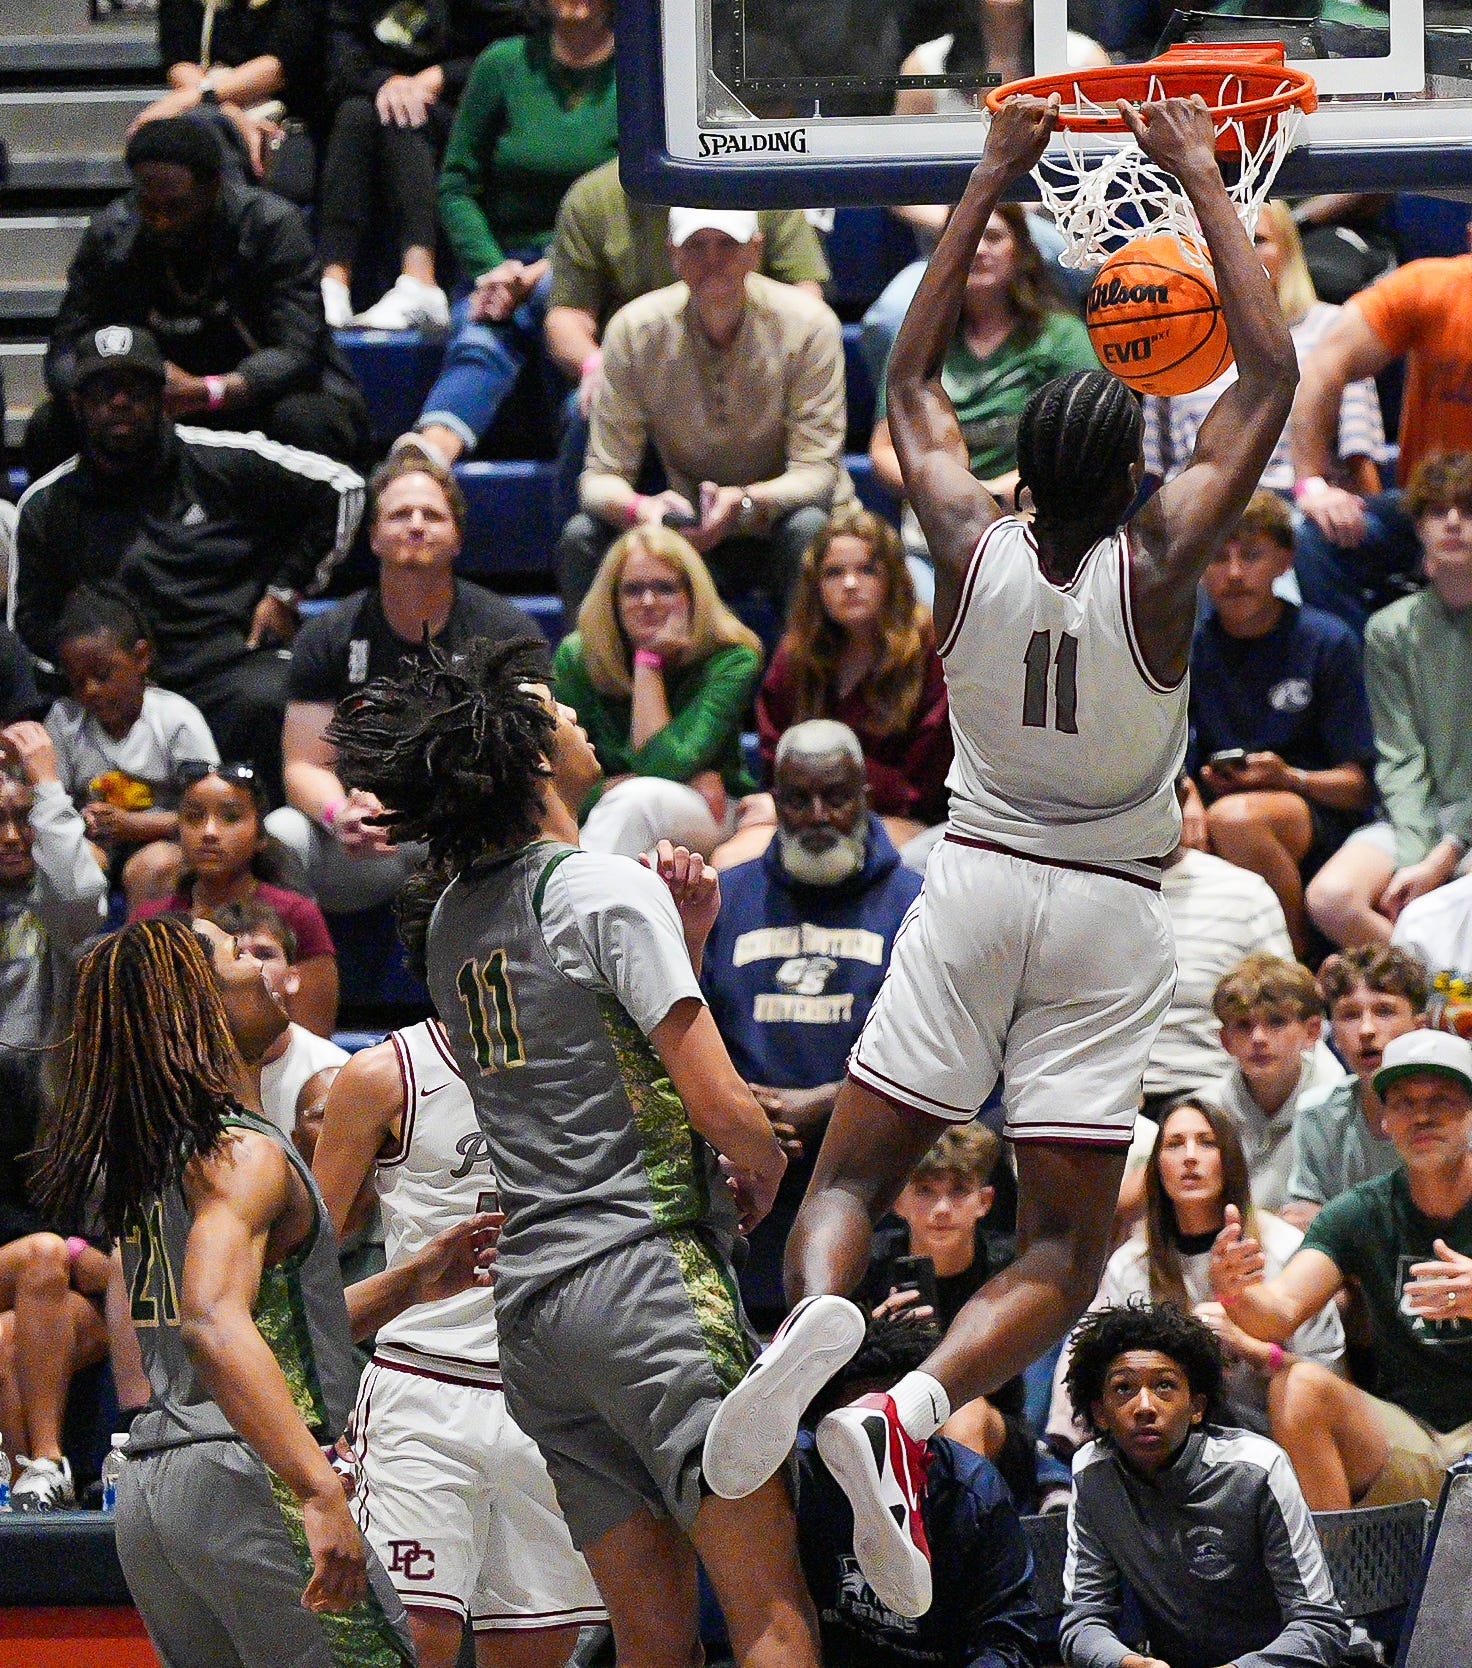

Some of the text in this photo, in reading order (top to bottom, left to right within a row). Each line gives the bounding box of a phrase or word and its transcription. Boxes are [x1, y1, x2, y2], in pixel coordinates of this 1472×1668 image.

[698, 128, 806, 158] SPALDING
[1103, 337, 1152, 364] EVO
[1022, 628, 1079, 735] 11
[456, 948, 527, 1077] 11
[387, 1540, 436, 1581] PC
